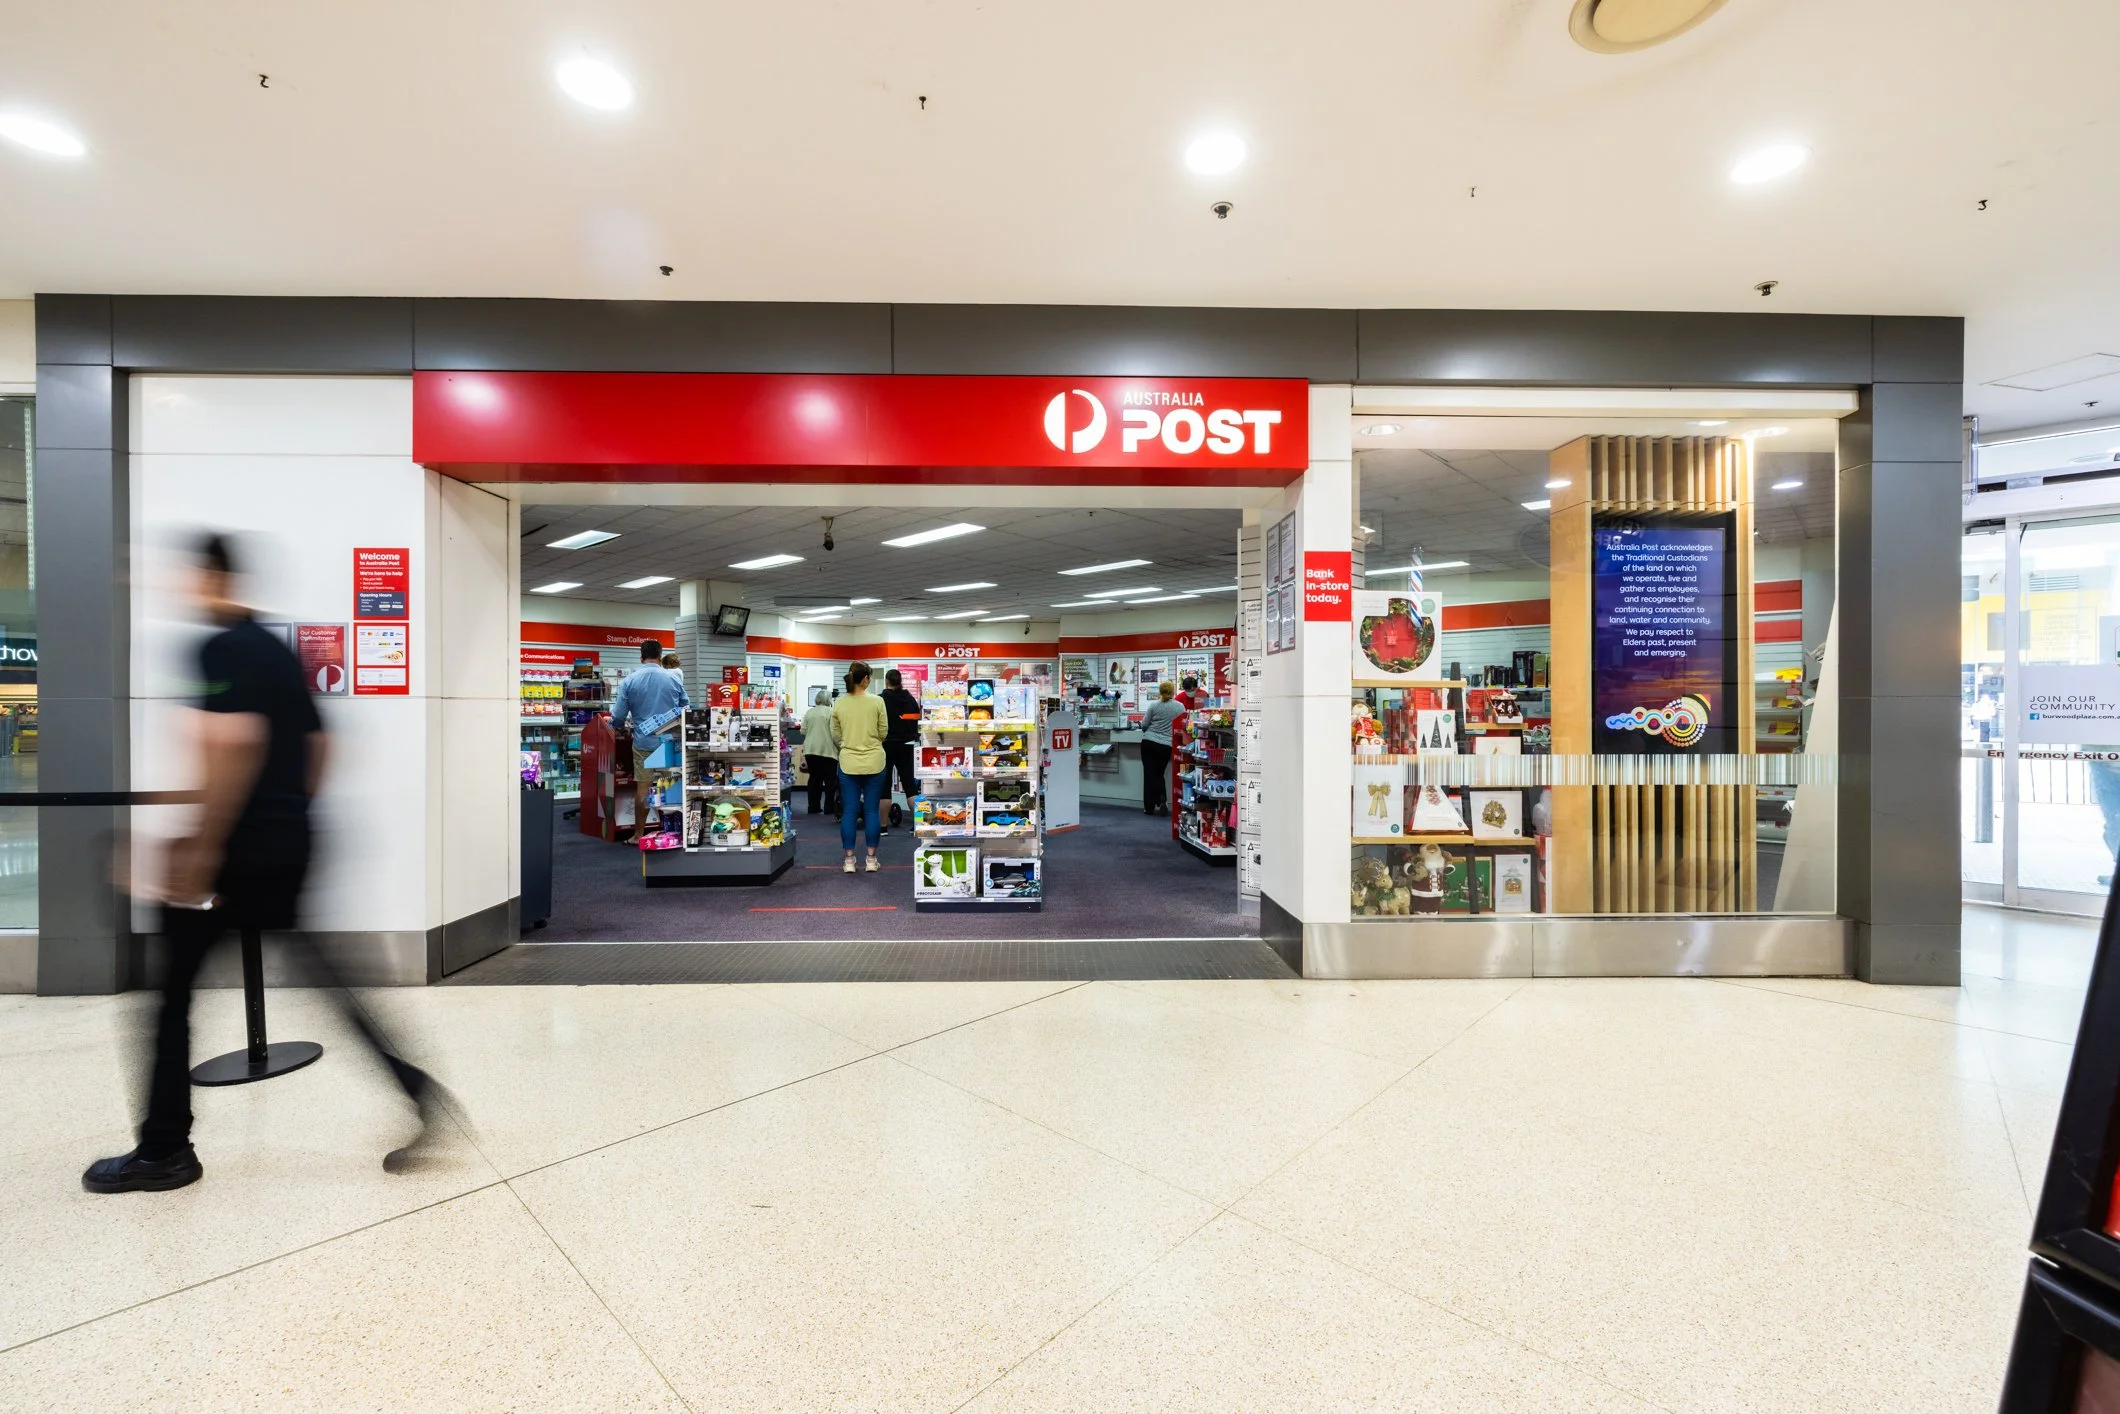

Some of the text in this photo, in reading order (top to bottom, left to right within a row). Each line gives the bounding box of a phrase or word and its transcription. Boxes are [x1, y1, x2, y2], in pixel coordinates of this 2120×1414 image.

[1123, 392, 1204, 406] AUSTRALIA
[1122, 408, 1282, 455] POST
[1660, 544, 1713, 552] acknowledges
[1306, 569, 1334, 578] Bank
[1635, 575, 1666, 583] operate,
[1306, 593, 1342, 604] today.
[1614, 606, 1653, 614] continuing
[1609, 616, 1628, 624] land,
[1669, 616, 1711, 624] community.
[606, 635, 627, 644] Stamp
[1192, 634, 1225, 647] POST
[948, 648, 980, 657] POST
[1055, 735, 1069, 748] TV
